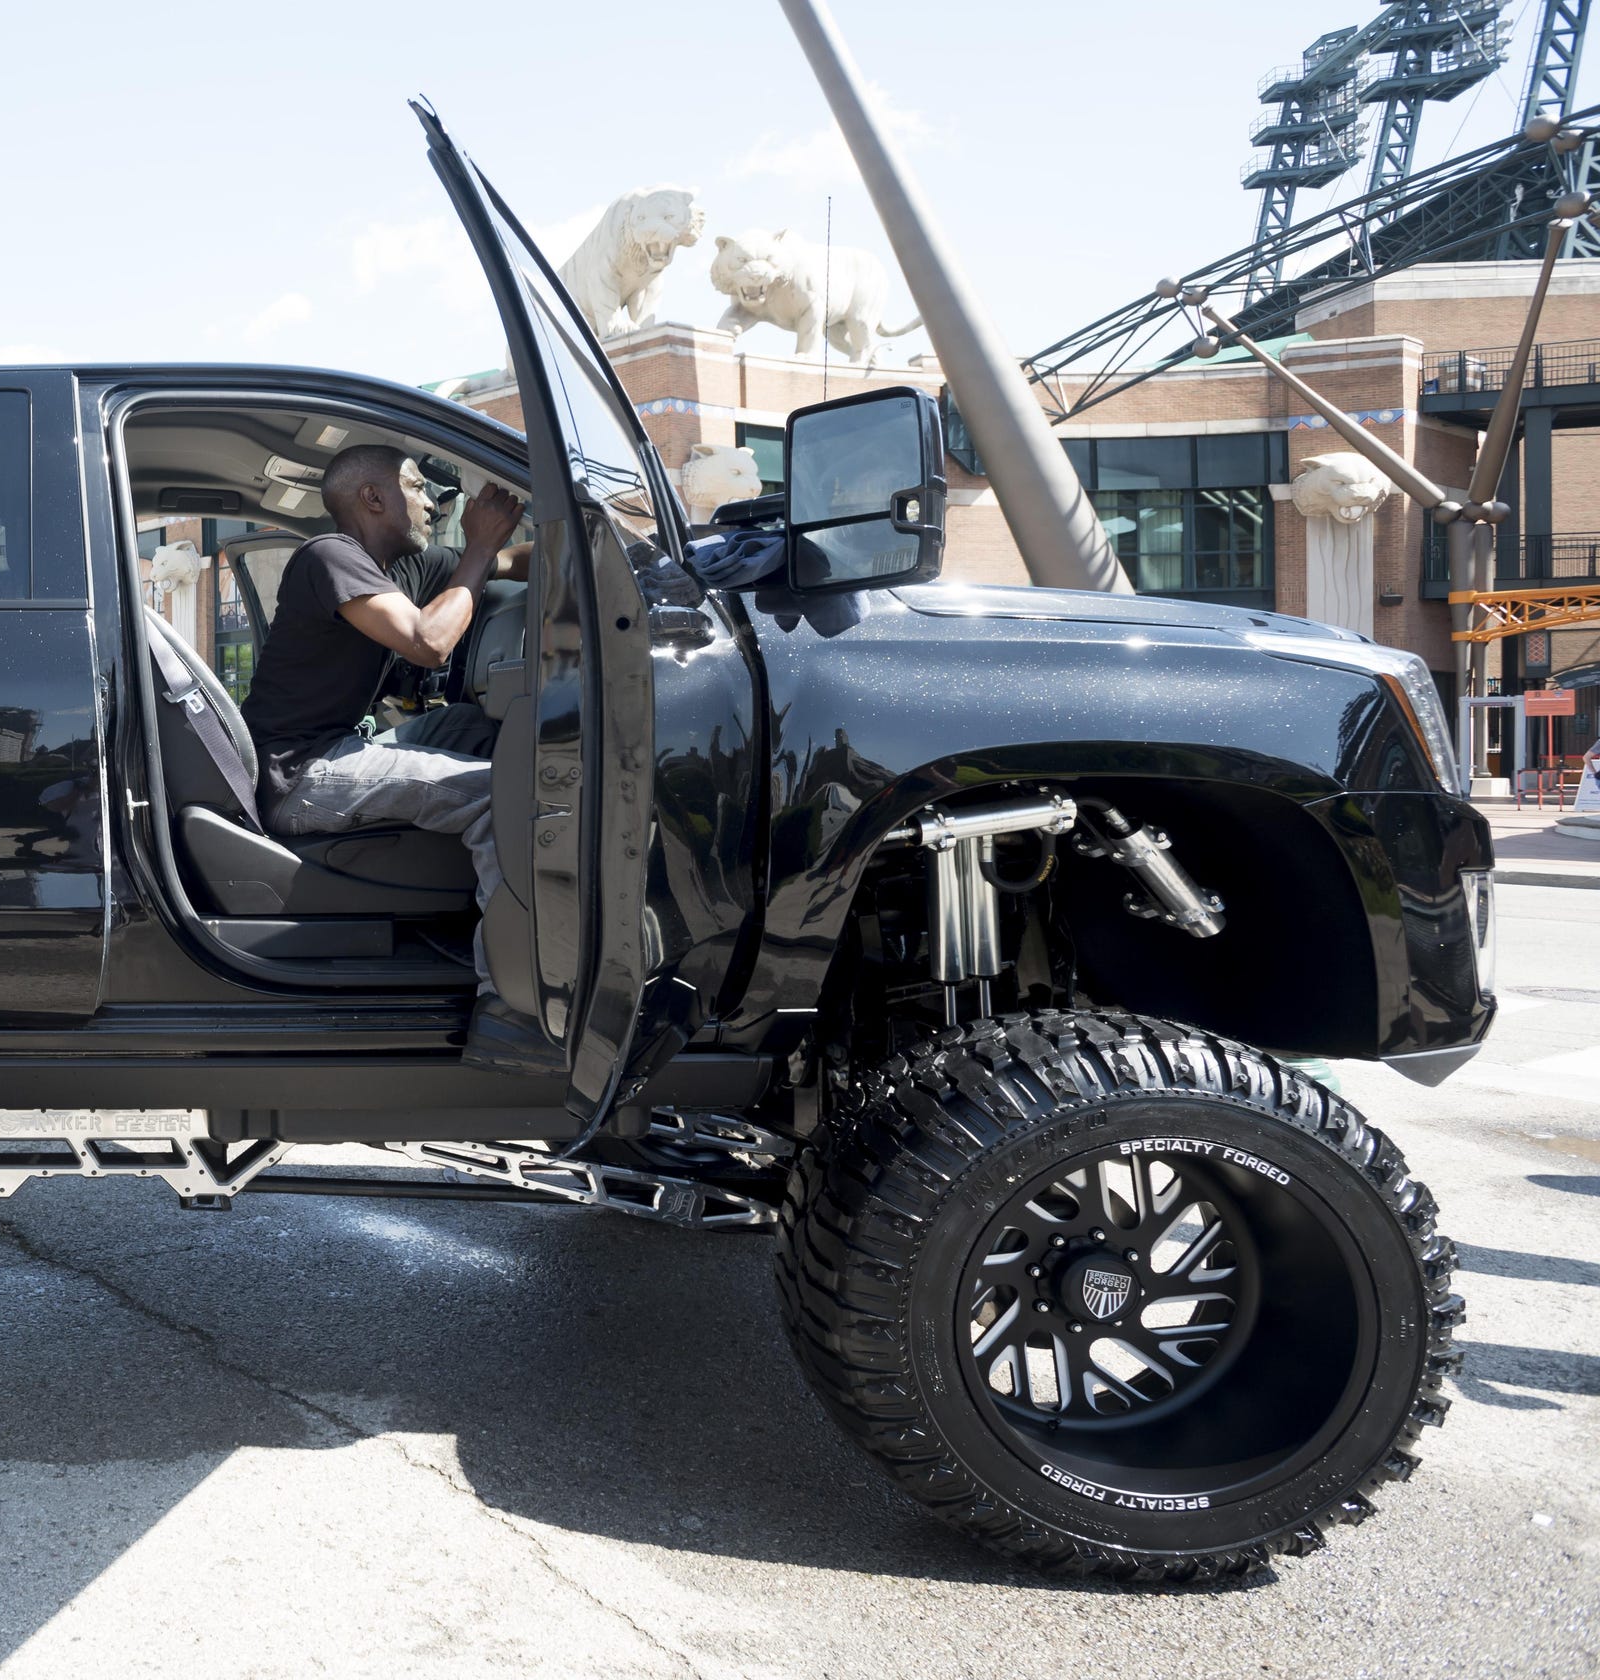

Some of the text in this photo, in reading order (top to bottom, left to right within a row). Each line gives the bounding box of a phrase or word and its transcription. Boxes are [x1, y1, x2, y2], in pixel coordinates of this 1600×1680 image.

[114, 1122, 192, 1133] DESIGN
[1119, 1140, 1291, 1186] SPECIALTY FORGED
[1088, 1271, 1128, 1283] SPECIALTY
[1088, 1276, 1127, 1289] FORGED
[1040, 1464, 1210, 1511] SPECIALTY FORGED
